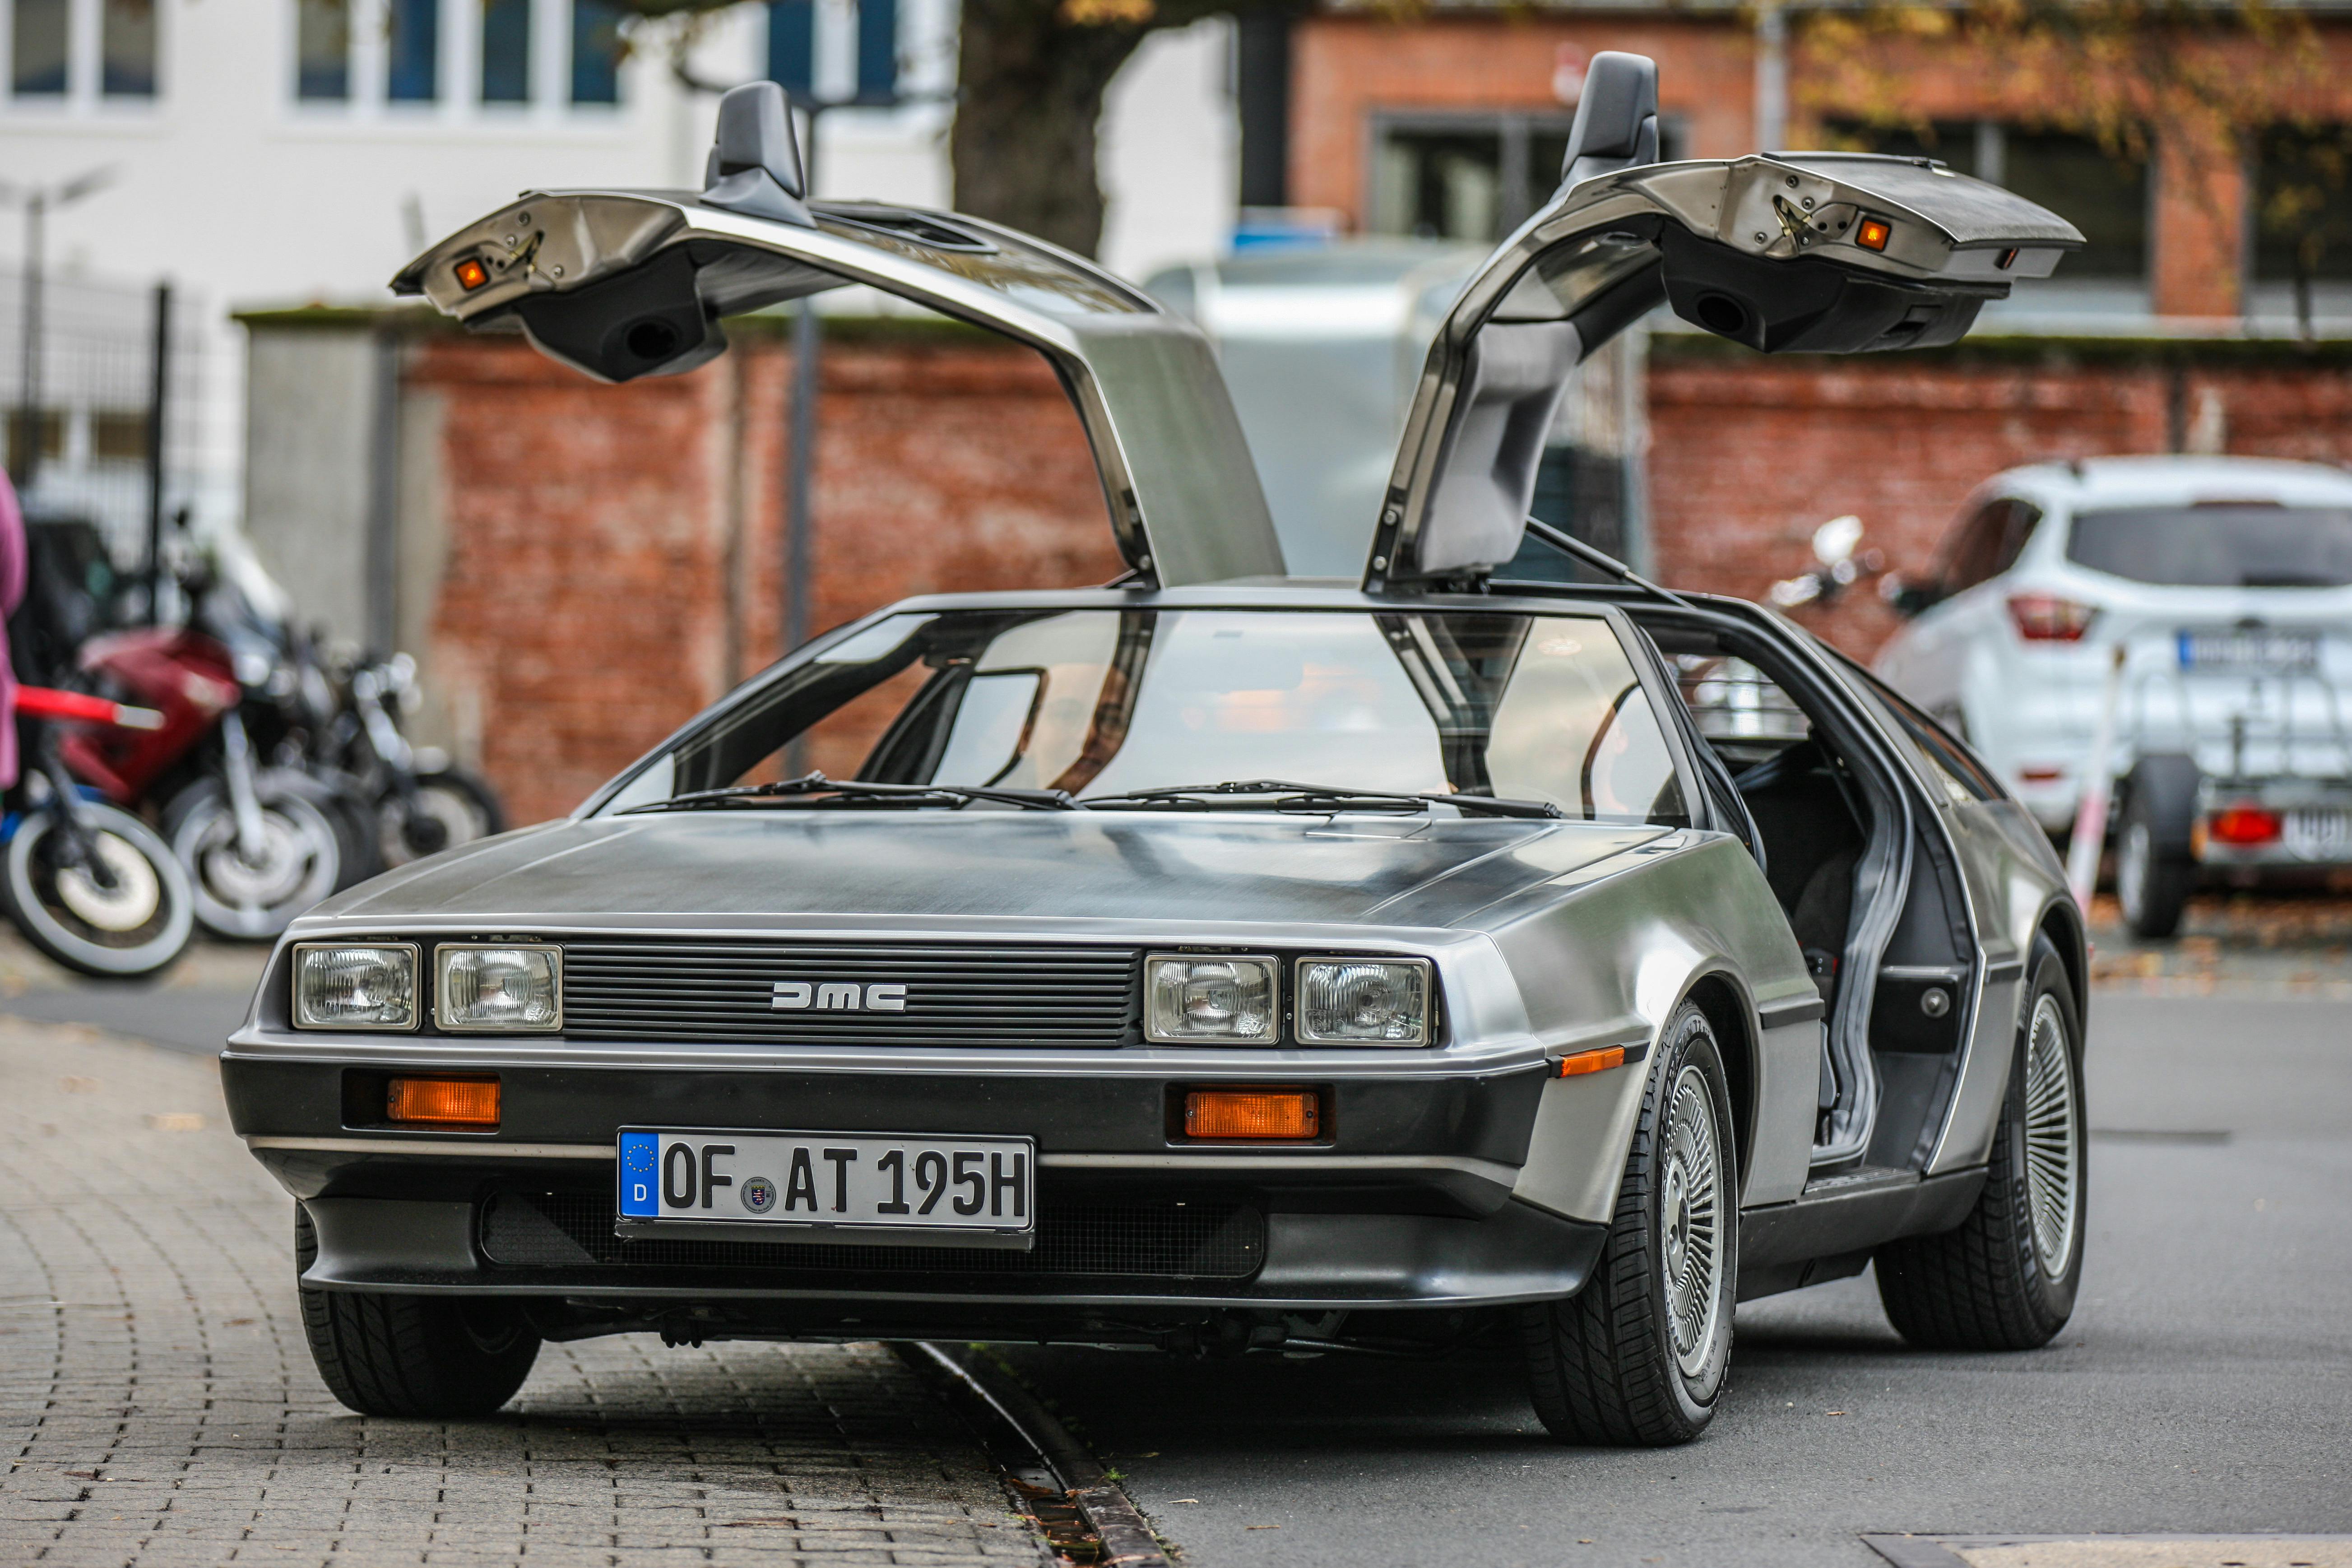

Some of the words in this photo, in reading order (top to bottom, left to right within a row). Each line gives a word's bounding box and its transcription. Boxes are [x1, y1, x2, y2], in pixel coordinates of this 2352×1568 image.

[634, 1184, 647, 1202] D
[663, 1142, 736, 1208] OF
[785, 1146, 857, 1212] AT
[877, 1149, 1026, 1216] 195H
